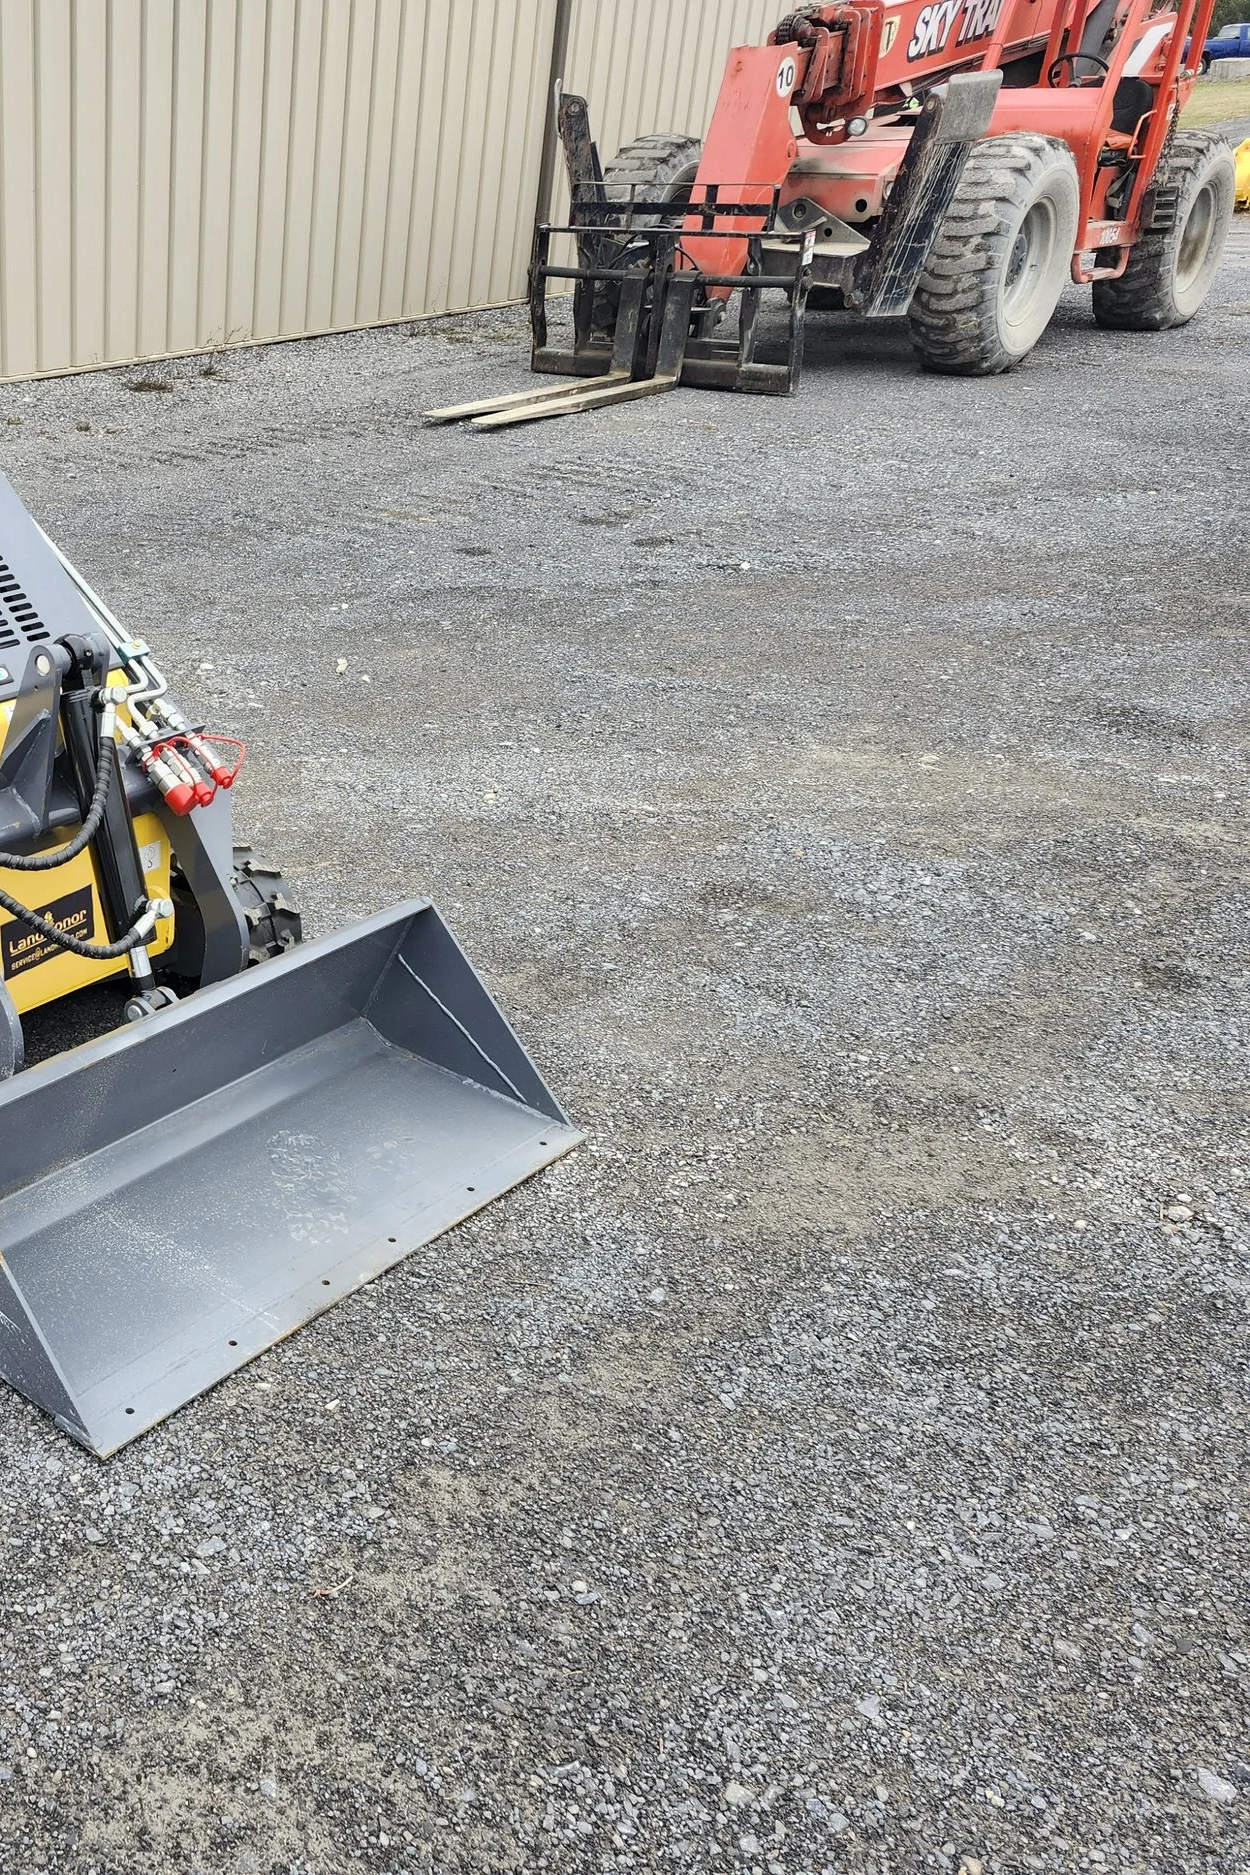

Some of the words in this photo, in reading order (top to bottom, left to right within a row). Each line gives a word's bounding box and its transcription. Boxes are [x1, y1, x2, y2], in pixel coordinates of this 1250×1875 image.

[907, 0, 963, 62] SKY
[955, 0, 1004, 47] TRA
[778, 64, 794, 89] 10
